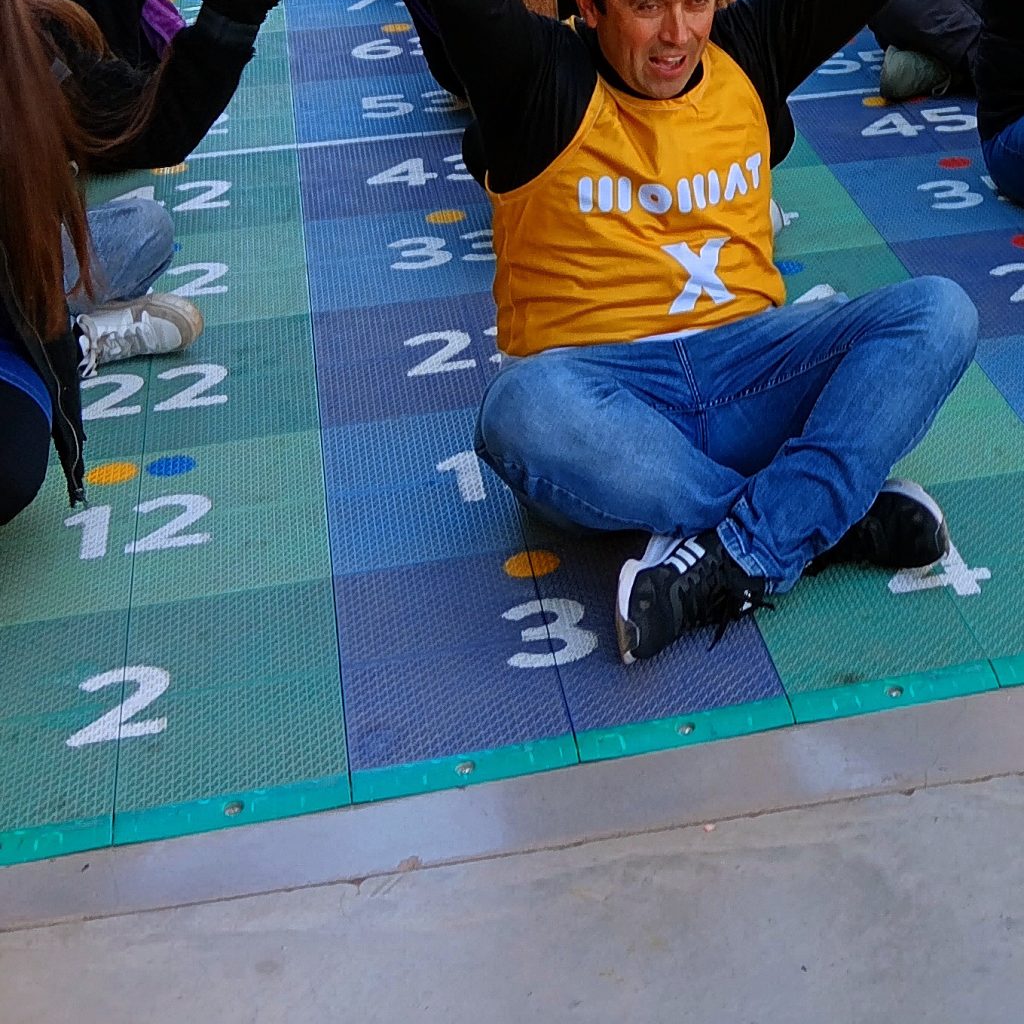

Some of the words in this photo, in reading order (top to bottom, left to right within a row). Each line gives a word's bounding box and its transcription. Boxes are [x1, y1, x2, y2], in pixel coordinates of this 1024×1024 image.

[351, 38, 422, 59] 6
[861, 107, 978, 137] 45
[404, 326, 501, 377] 2
[81, 363, 228, 421] 22
[64, 494, 212, 561] 12
[502, 597, 599, 669] 3
[66, 665, 171, 748] 2
